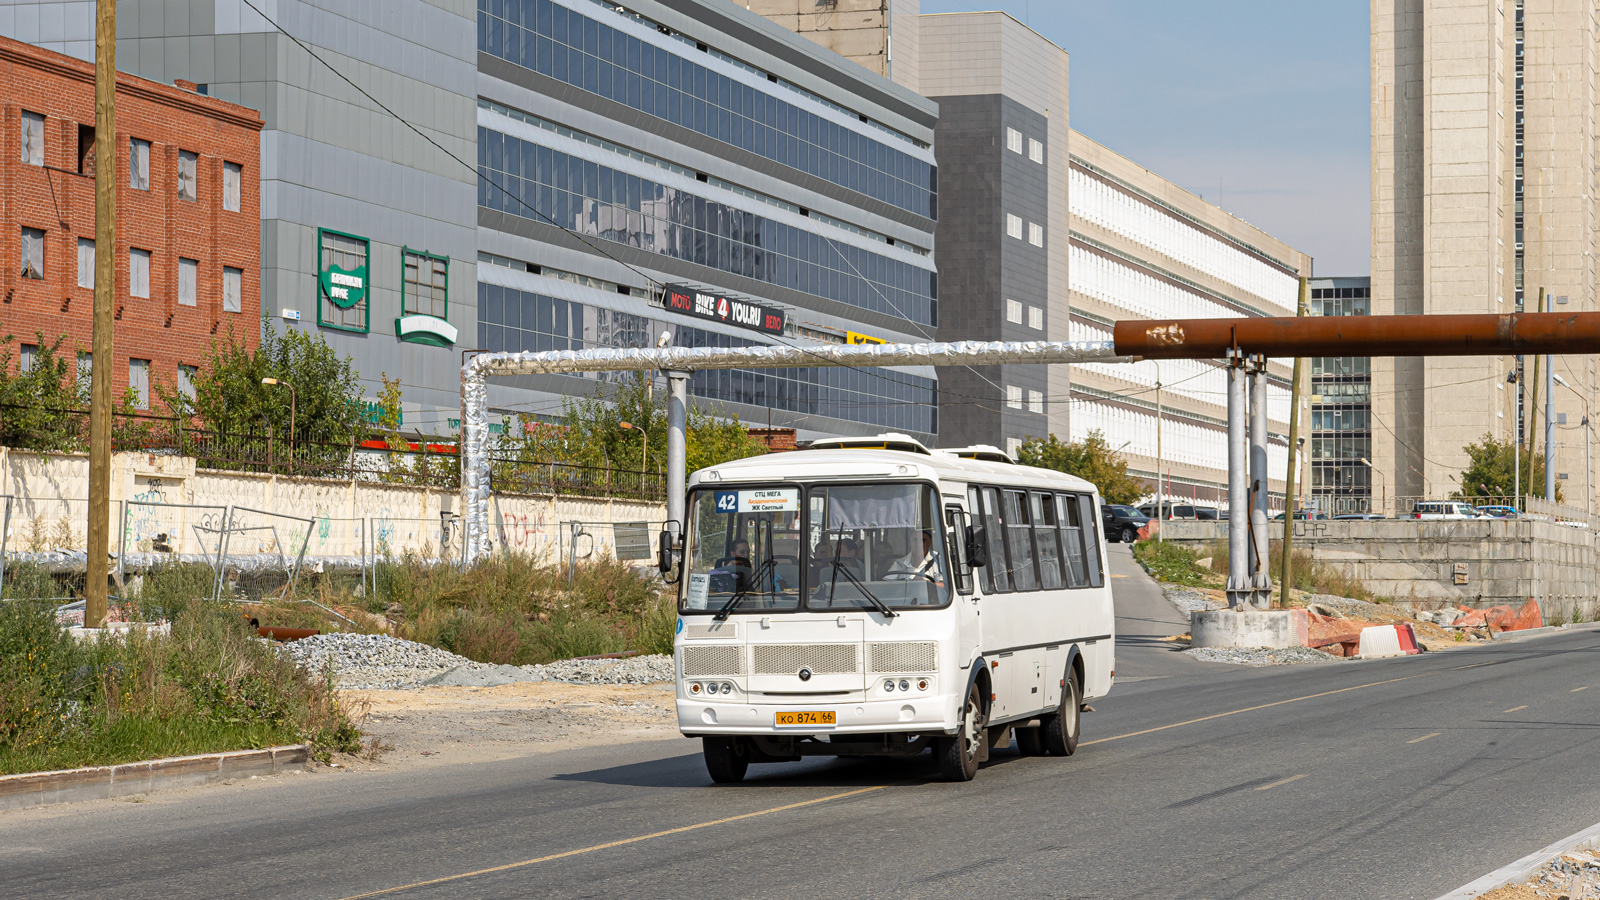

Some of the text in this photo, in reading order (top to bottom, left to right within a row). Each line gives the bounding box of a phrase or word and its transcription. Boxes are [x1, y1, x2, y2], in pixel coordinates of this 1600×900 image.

[671, 292, 691, 311] МОТО
[695, 293, 761, 327] BIKE 4 YOU.RU
[765, 314, 781, 331] ВЕЛО
[718, 494, 736, 510] 42
[781, 715, 794, 724] КО
[797, 713, 817, 723] 874
[822, 712, 833, 721] 66
